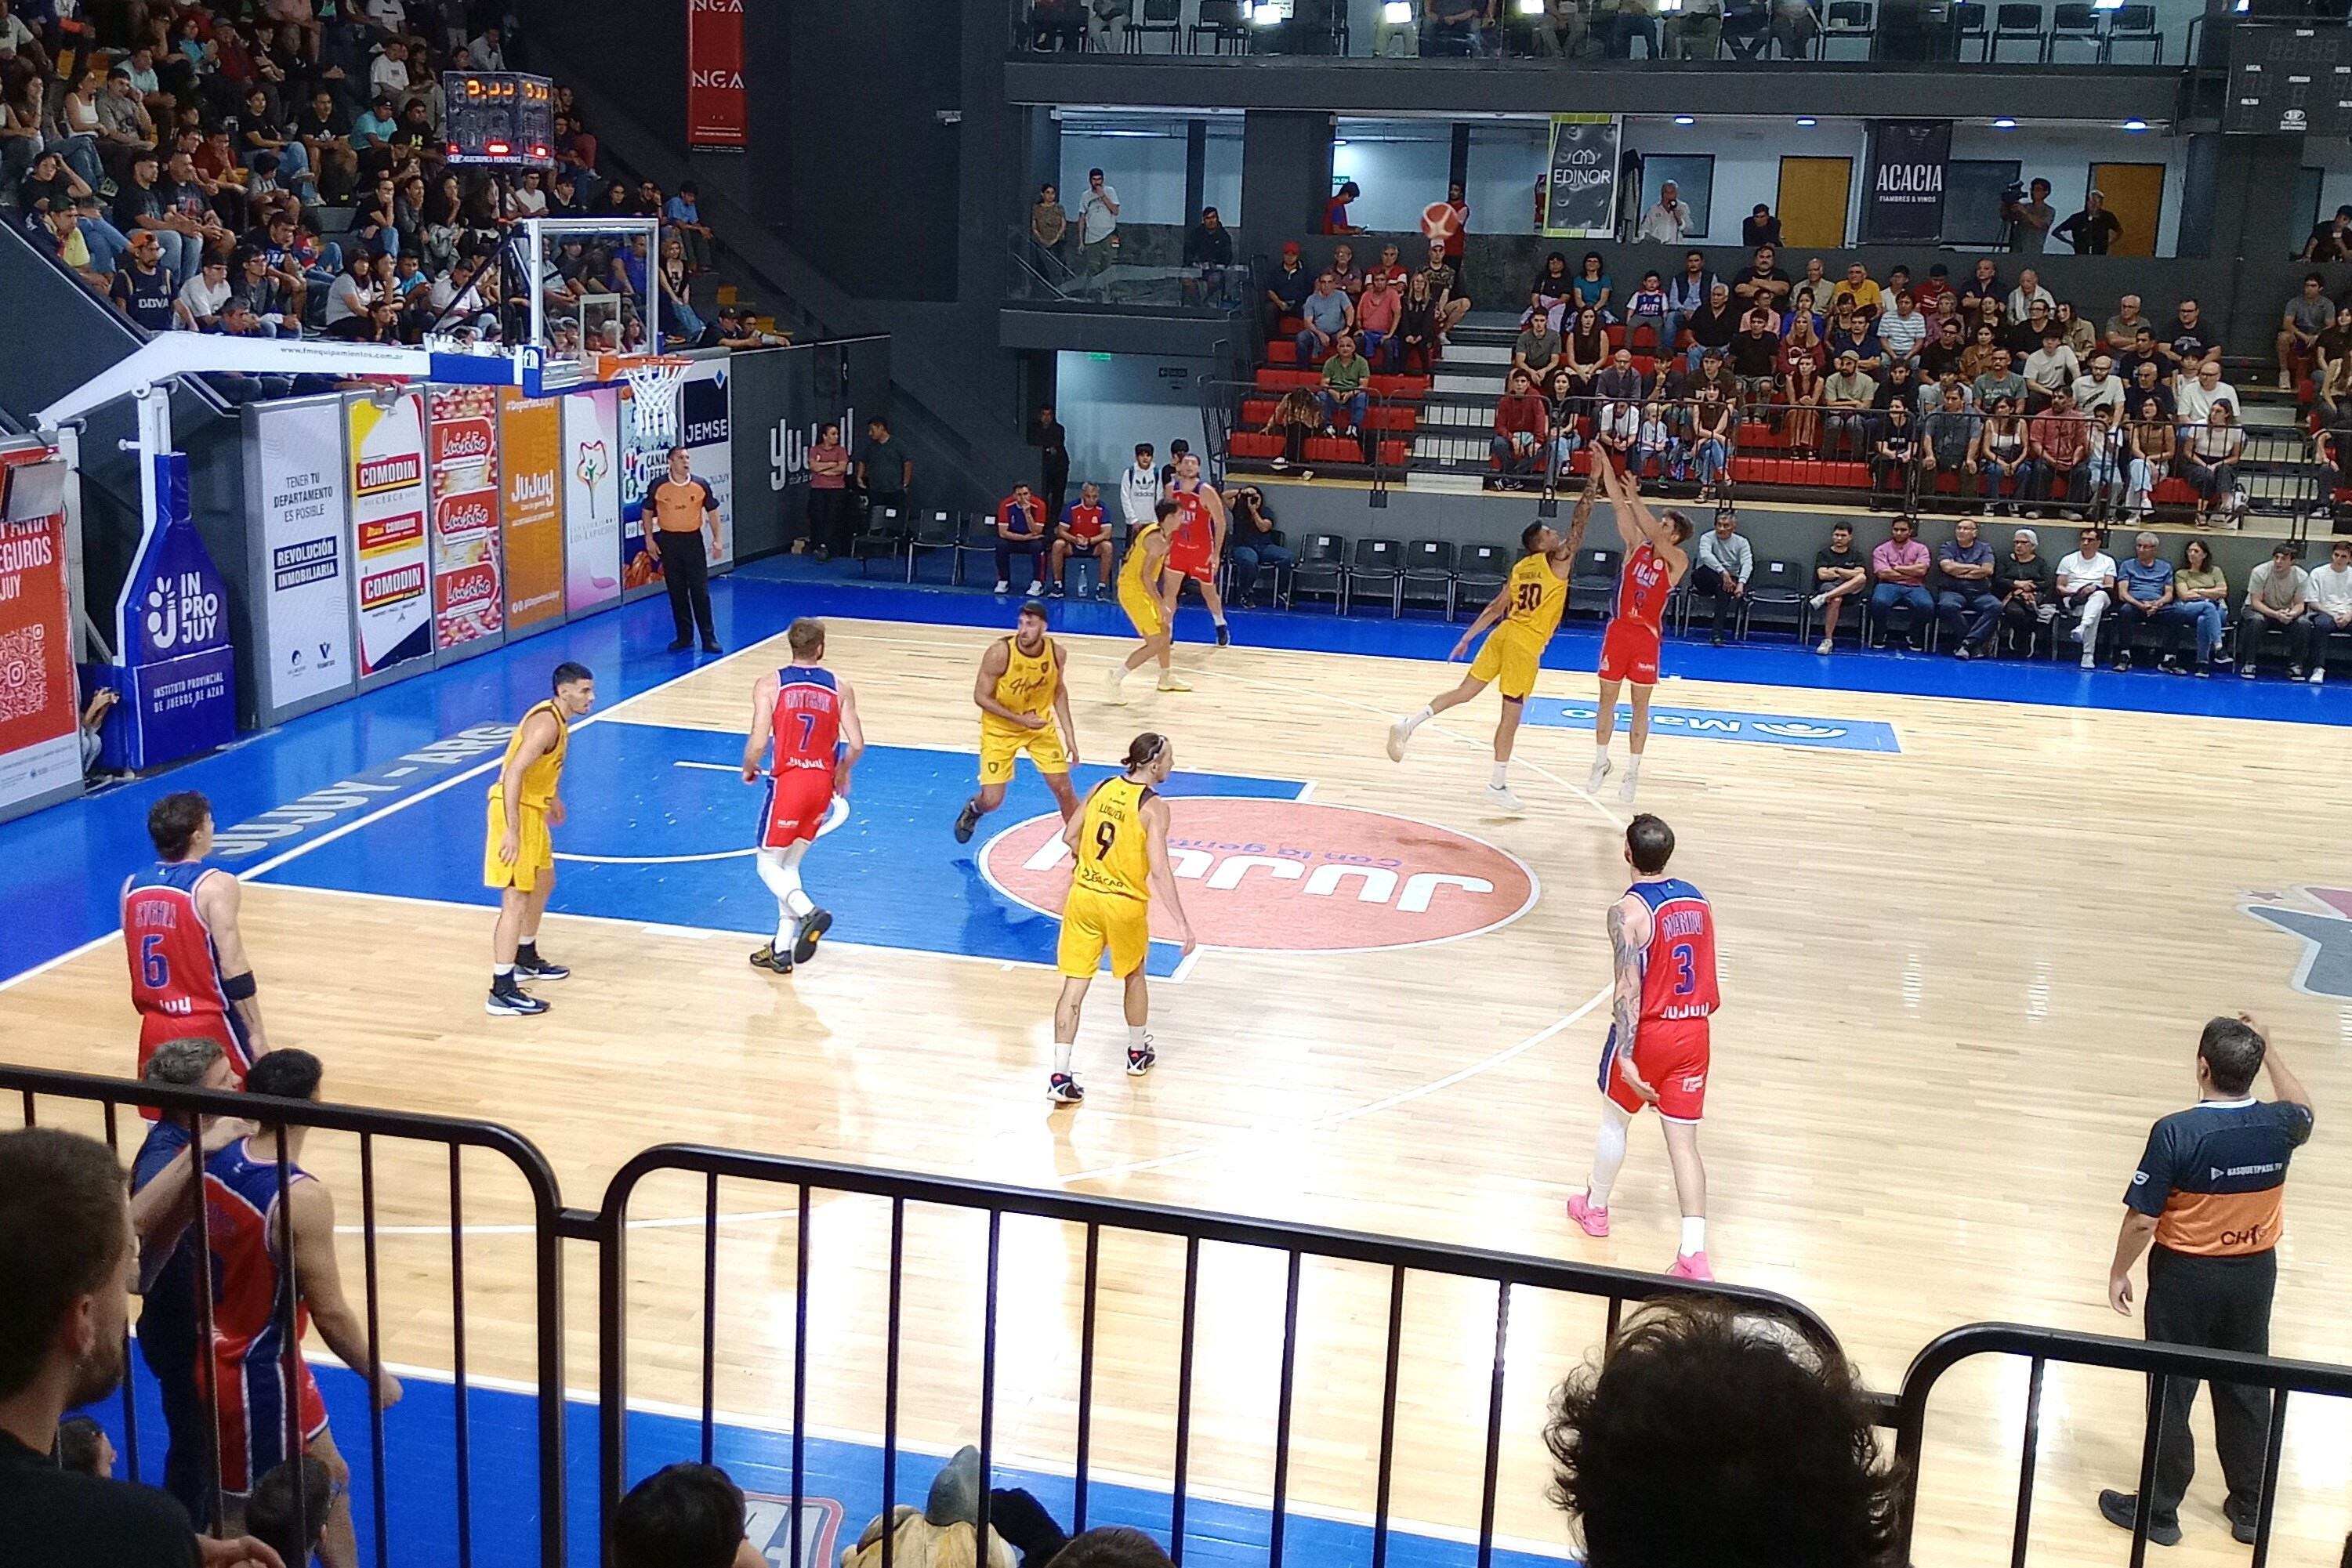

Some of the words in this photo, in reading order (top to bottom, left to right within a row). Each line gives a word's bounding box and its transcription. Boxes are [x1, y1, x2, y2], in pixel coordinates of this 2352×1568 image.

[692, 70, 745, 89] NGA
[1554, 169, 1611, 184] EDINOR
[1876, 164, 1942, 192] ACACIA
[687, 419, 727, 444] JEMSE
[286, 473, 309, 489] TENER
[310, 472, 320, 484] TU
[361, 460, 417, 489] COMODIN
[274, 486, 333, 509] DEPARTAMENTO
[284, 510, 294, 523] ES
[295, 504, 325, 520] POSIBLE
[277, 538, 335, 567] REVOLUCIÓN
[180, 571, 201, 598] IN
[277, 561, 335, 588] INMOBILIARIA
[365, 567, 422, 599] COMODIN
[182, 593, 218, 621] PRO
[1518, 583, 1542, 611] 30
[182, 615, 217, 644] JUY
[154, 680, 186, 699] INSTITUTO
[187, 672, 223, 690] PROVINCIAL
[154, 700, 163, 713] DE
[166, 693, 193, 710] JUEGOS
[195, 690, 205, 702] DE
[207, 685, 224, 699] AZAR
[796, 713, 815, 752] 7
[1561, 708, 1741, 733] Mao
[1096, 820, 1115, 861] 9
[141, 933, 171, 989] 6
[1672, 943, 1696, 996] 3
